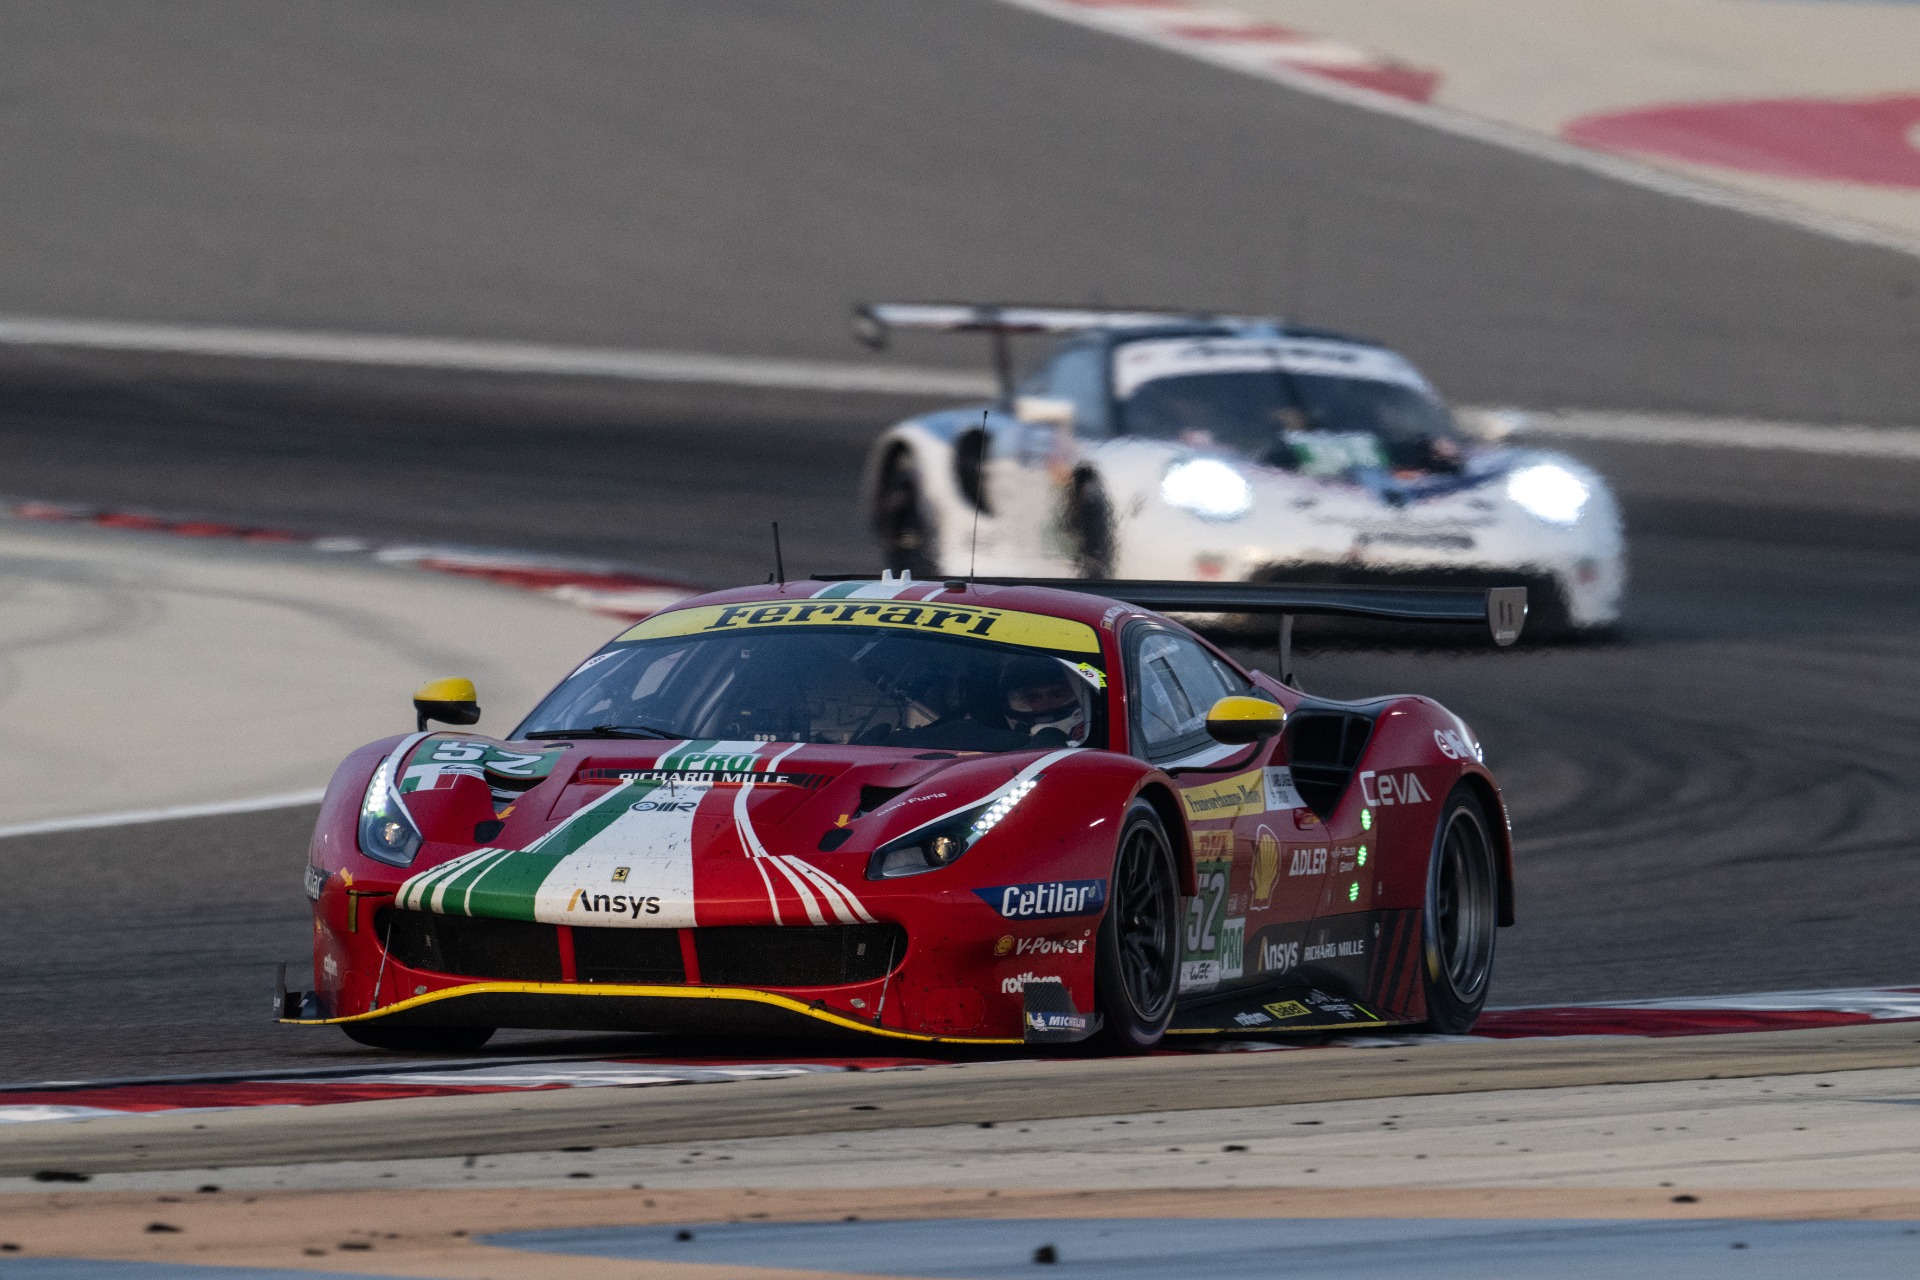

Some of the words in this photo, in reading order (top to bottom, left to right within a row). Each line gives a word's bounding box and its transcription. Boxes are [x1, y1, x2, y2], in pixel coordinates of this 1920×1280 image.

[704, 599, 1001, 637] Ferrari
[431, 741, 544, 776] 52
[680, 754, 755, 772] PRO
[1289, 848, 1327, 876] ADLER
[567, 888, 660, 920] Ansys
[1001, 883, 1090, 917] Cetilar
[1188, 871, 1226, 952] 52
[1015, 937, 1087, 955] V-Power
[1220, 926, 1246, 971] PRO
[1256, 935, 1299, 975] Ansys
[1303, 943, 1337, 962] RICHARD
[1337, 940, 1364, 956] MILLE
[1048, 1015, 1087, 1028] MICHELIN
